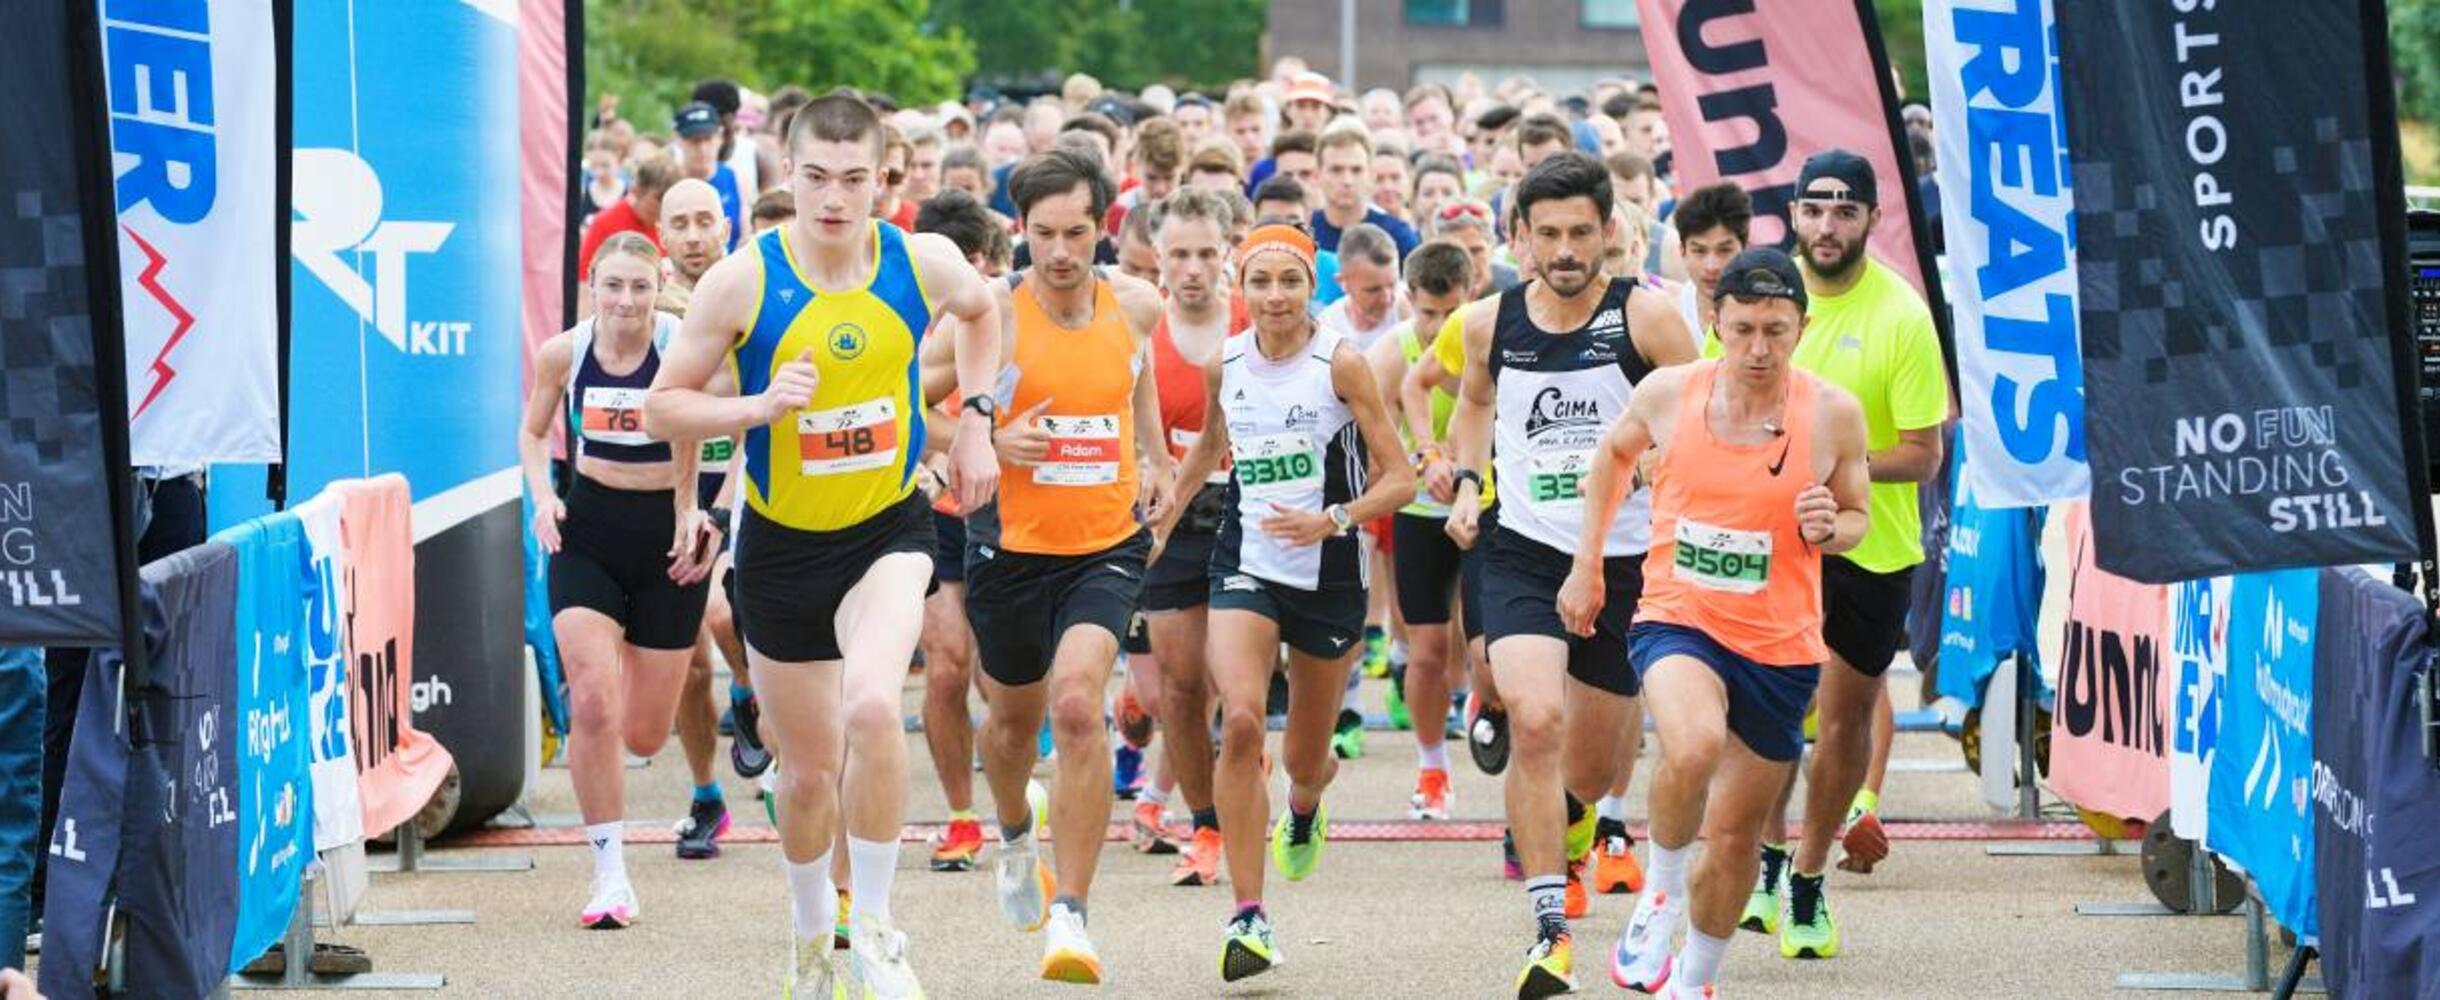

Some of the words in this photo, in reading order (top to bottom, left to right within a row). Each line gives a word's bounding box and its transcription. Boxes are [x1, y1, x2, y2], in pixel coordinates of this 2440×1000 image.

[411, 322, 470, 355] KIT
[604, 407, 638, 432] 76
[2176, 413, 2247, 457] NO
[2255, 405, 2336, 449] FUN
[826, 427, 875, 456] 48
[1061, 444, 1103, 457] Adam
[1236, 453, 1312, 486] 3310
[2120, 450, 2350, 505] STANDING
[2268, 490, 2387, 532] STILL
[1676, 539, 1768, 583] 3504
[0, 569, 81, 606] ILL
